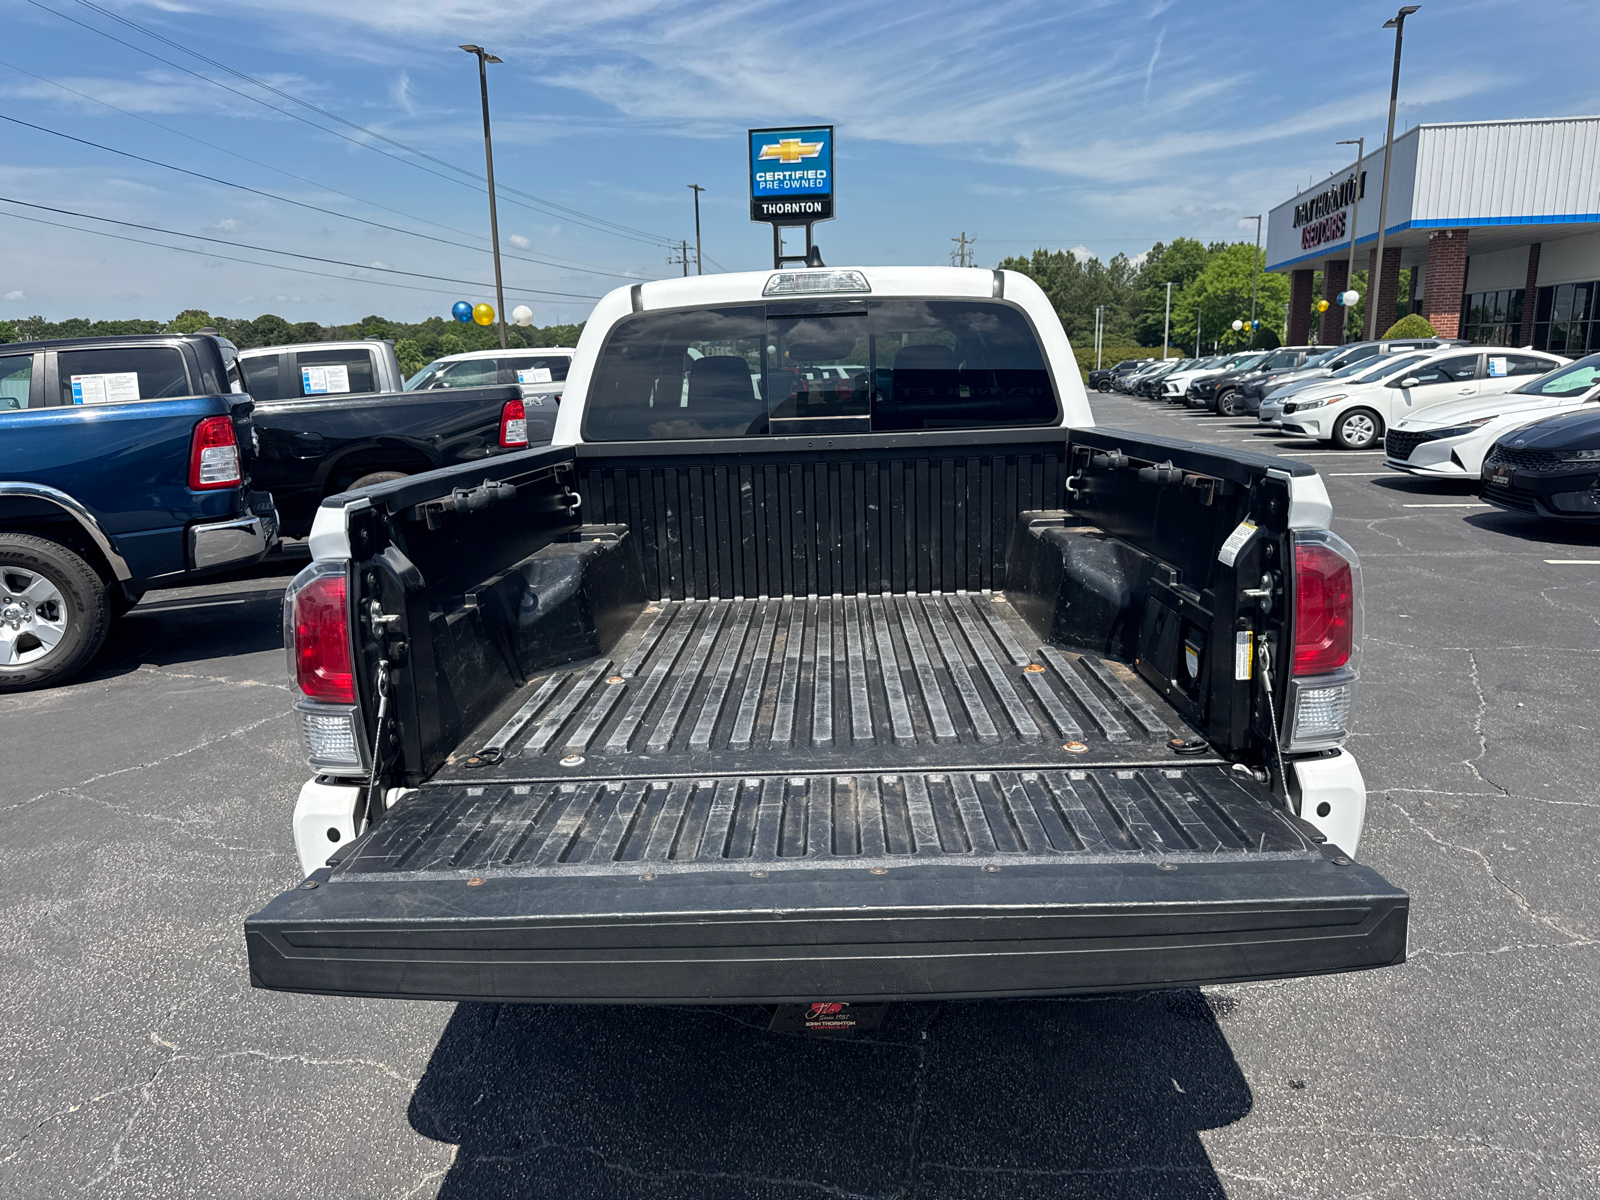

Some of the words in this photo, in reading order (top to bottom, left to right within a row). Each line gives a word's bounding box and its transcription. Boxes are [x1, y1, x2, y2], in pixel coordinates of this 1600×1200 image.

[756, 170, 827, 181] CERTIFIED
[759, 179, 823, 190] PRE-OWNED
[762, 202, 822, 214] THORNTON
[1302, 221, 1321, 249] USED
[1320, 211, 1346, 242] CARS
